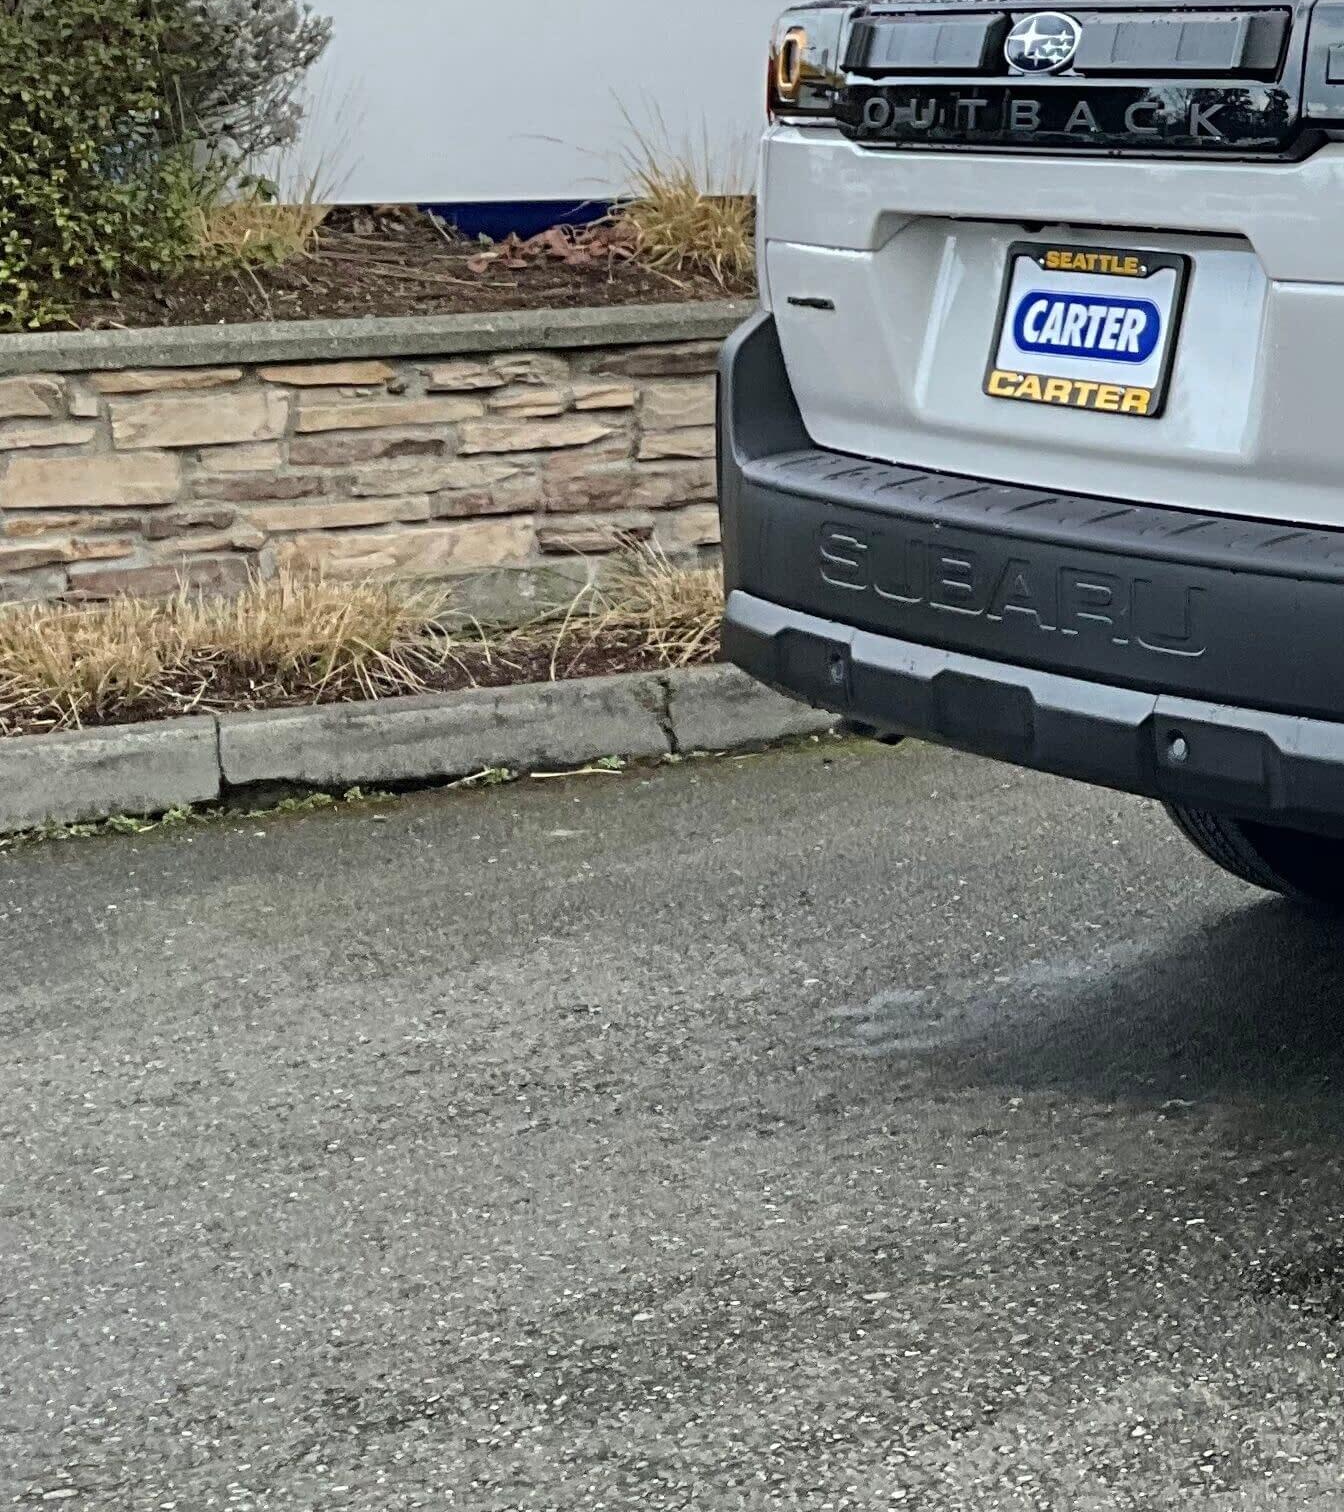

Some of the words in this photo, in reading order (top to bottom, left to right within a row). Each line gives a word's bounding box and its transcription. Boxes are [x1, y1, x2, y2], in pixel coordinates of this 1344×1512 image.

[862, 97, 1224, 138] OUTBACK
[1045, 250, 1139, 275] SEATTLE
[1023, 298, 1148, 354] CARTER
[987, 369, 1151, 415] CARTER
[818, 520, 1208, 658] SUBARU
